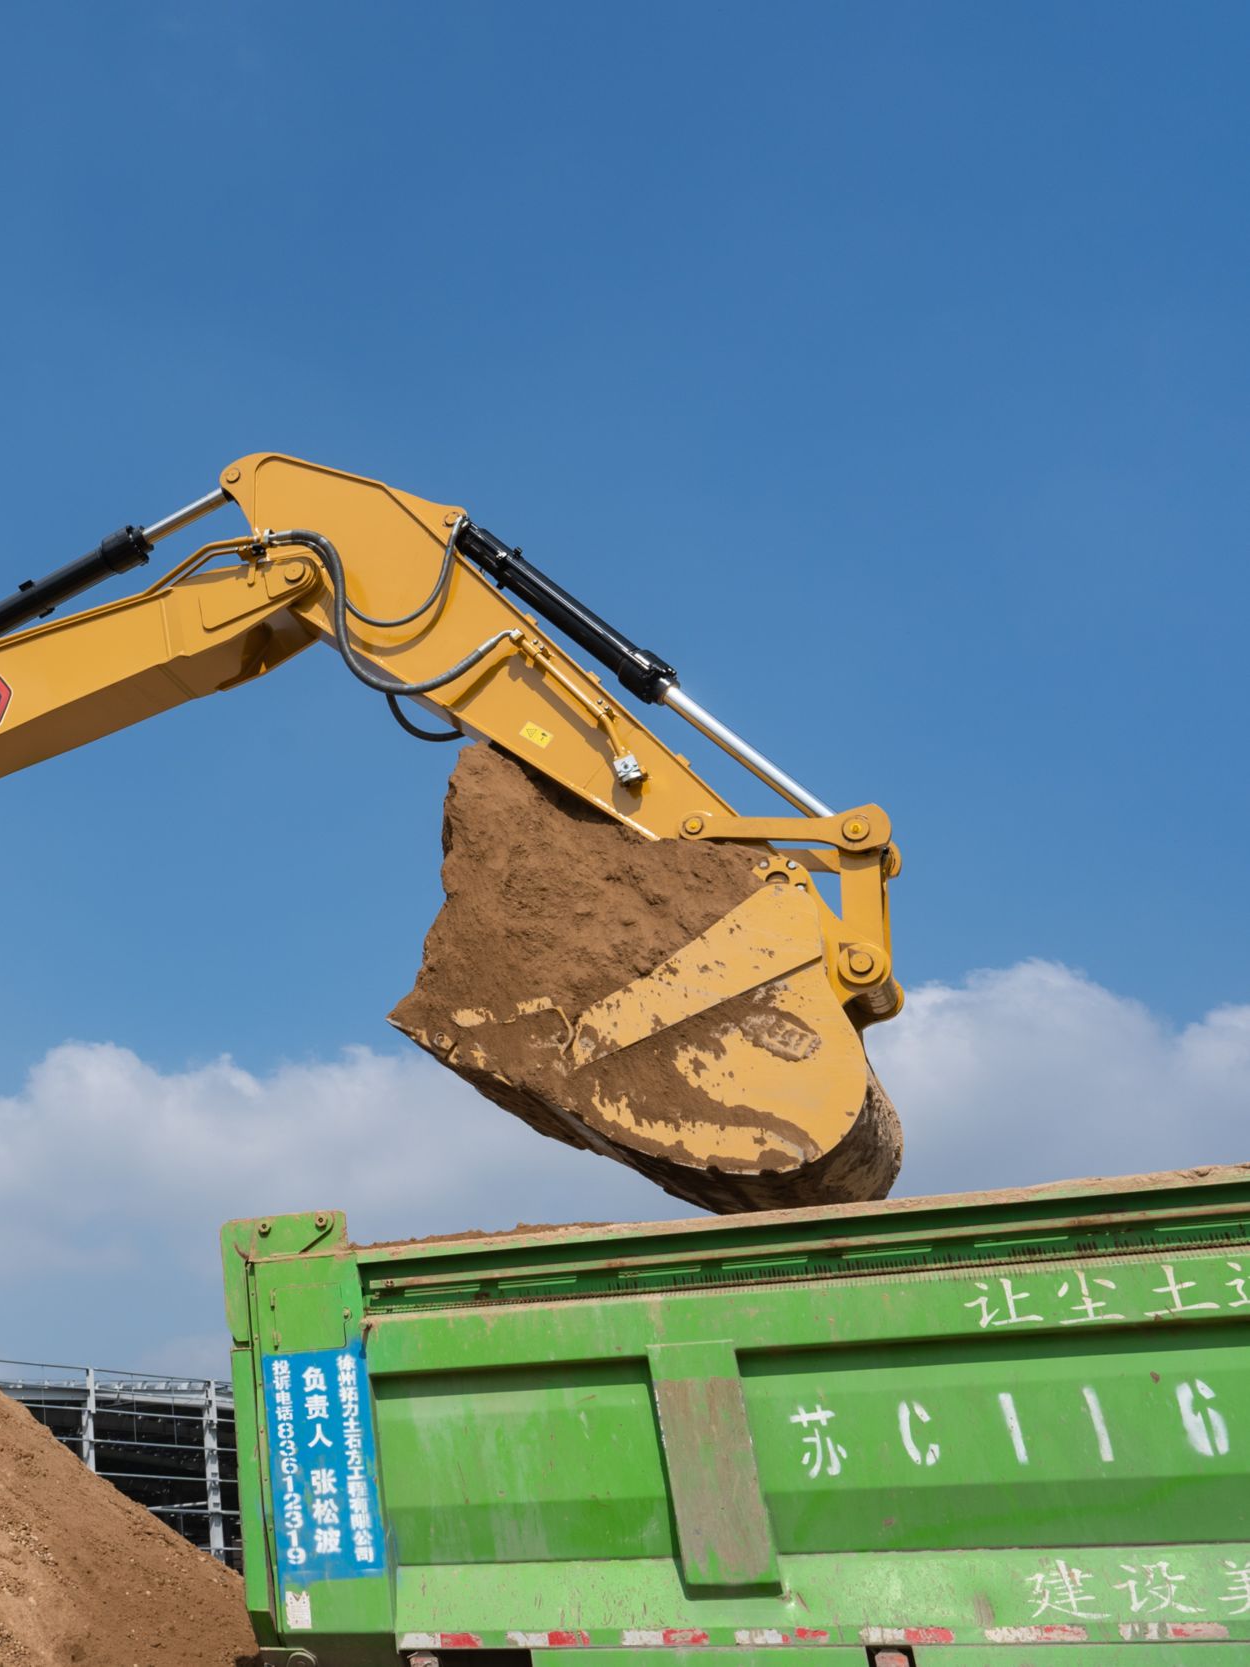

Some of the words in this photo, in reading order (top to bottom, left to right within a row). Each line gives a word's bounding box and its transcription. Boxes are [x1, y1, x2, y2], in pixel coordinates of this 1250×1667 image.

[302, 1366, 333, 1448] 负责人
[311, 1468, 342, 1554] 张松波
